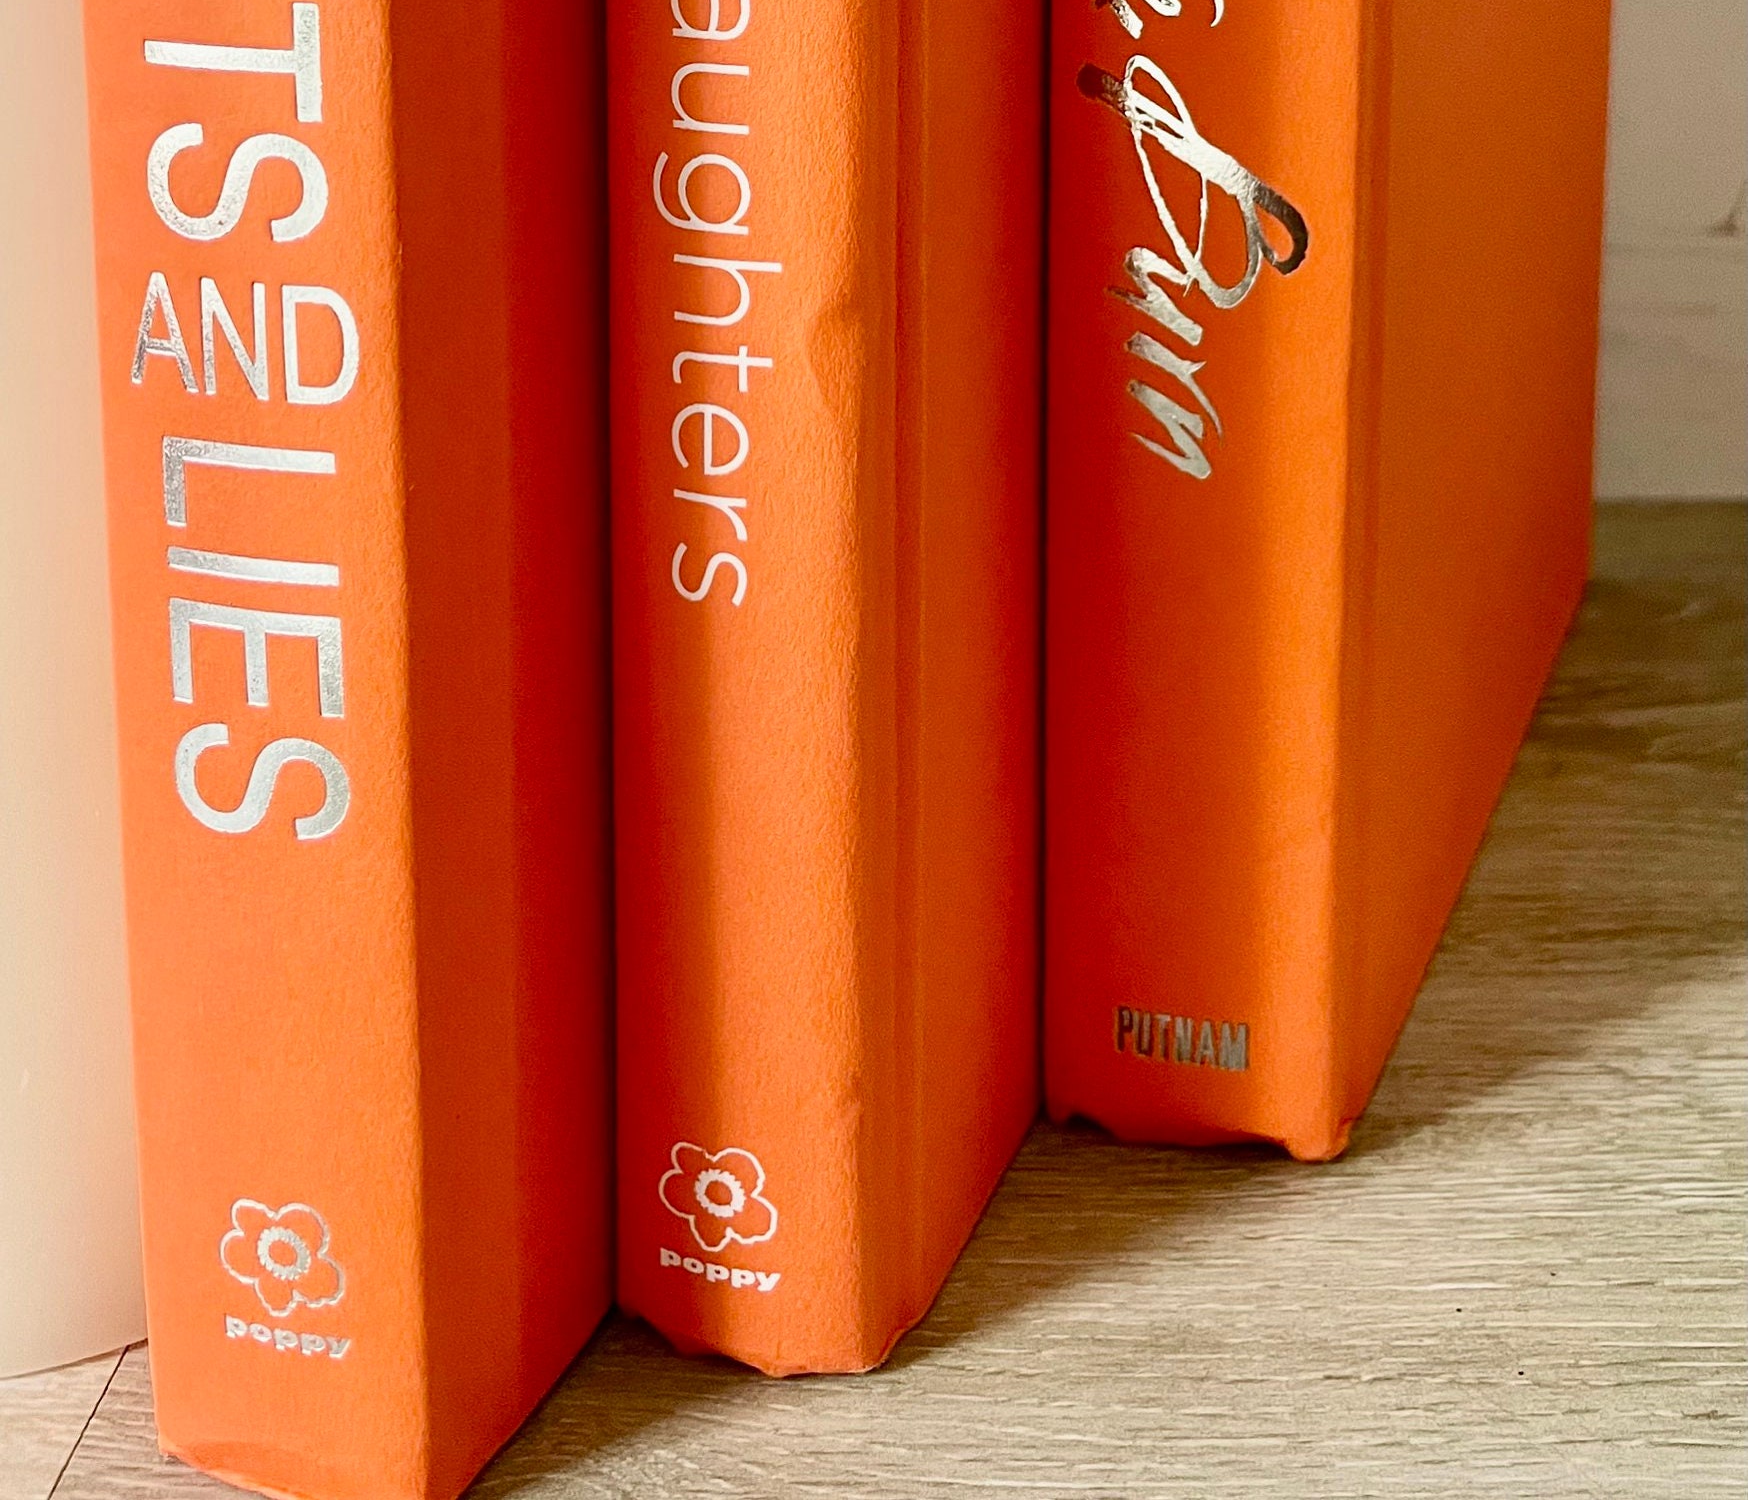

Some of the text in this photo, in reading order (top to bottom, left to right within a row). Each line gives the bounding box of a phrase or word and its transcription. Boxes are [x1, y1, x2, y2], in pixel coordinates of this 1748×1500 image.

[1075, 54, 1309, 480] Burn
[131, 271, 360, 406] AND
[162, 435, 351, 841] LIES
[1115, 1005, 1249, 1071] PUTNAM
[659, 1247, 781, 1292] poppy
[224, 1313, 351, 1358] poppy
